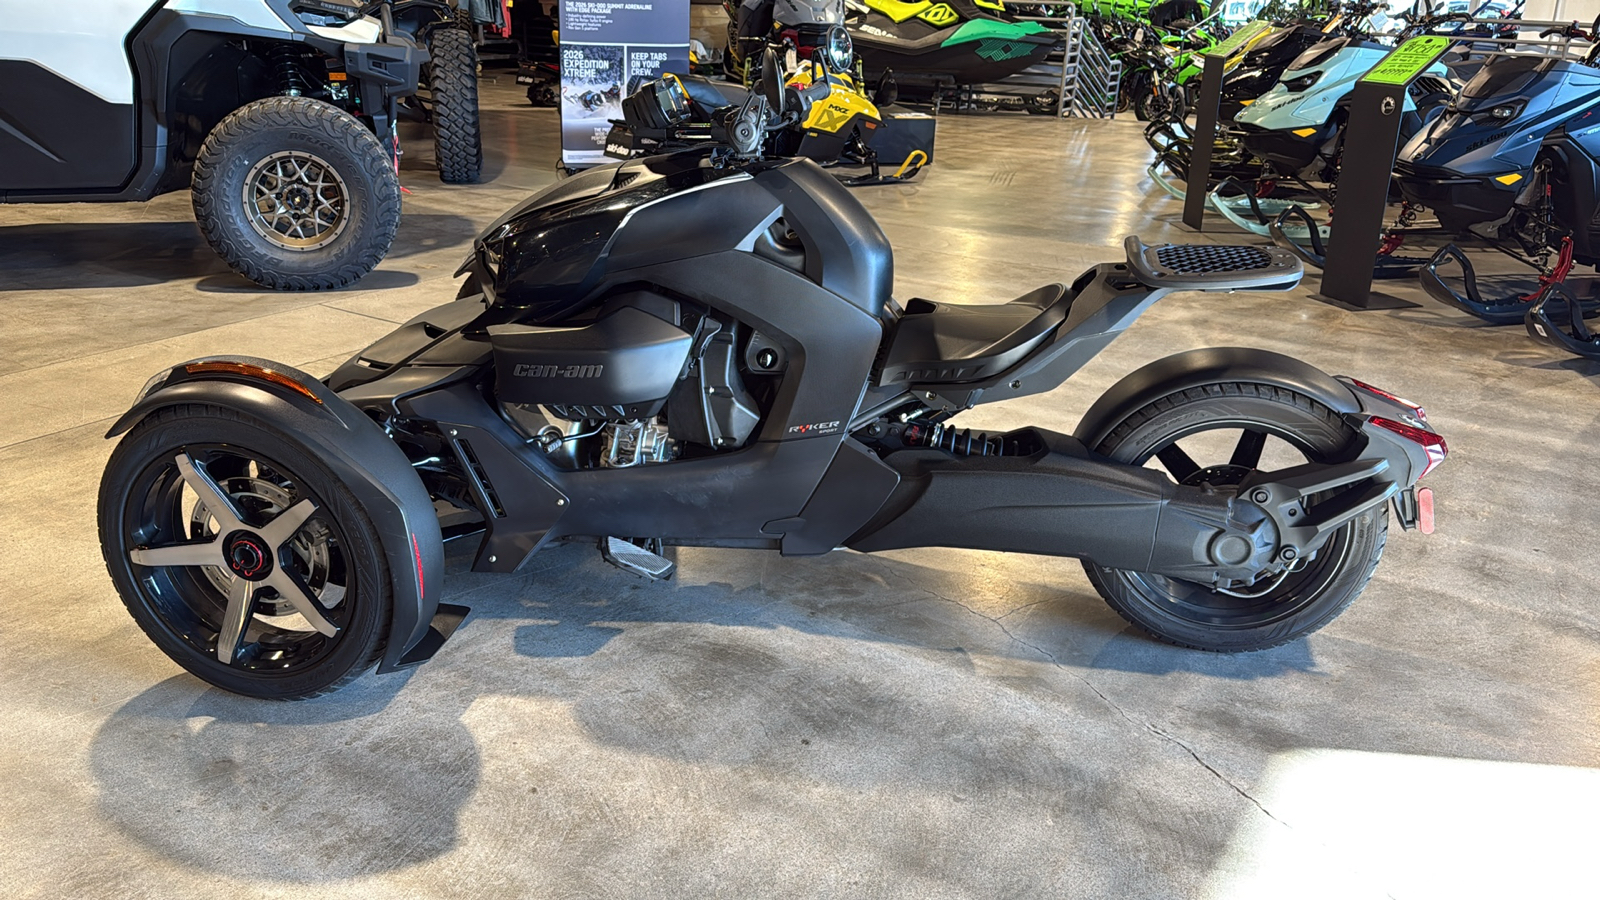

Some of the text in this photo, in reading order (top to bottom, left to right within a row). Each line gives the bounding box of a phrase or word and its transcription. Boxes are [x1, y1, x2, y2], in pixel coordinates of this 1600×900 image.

[563, 50, 584, 59] 2026
[631, 52, 667, 61] KEEP TABS
[564, 60, 609, 69] EXPEDITION
[631, 60, 660, 69] ON YOUR
[564, 69, 596, 78] XTREME
[631, 68, 653, 76] CREW.
[606, 143, 630, 156] ski-doo
[513, 363, 604, 379] can-am
[788, 420, 840, 434] RYKER
